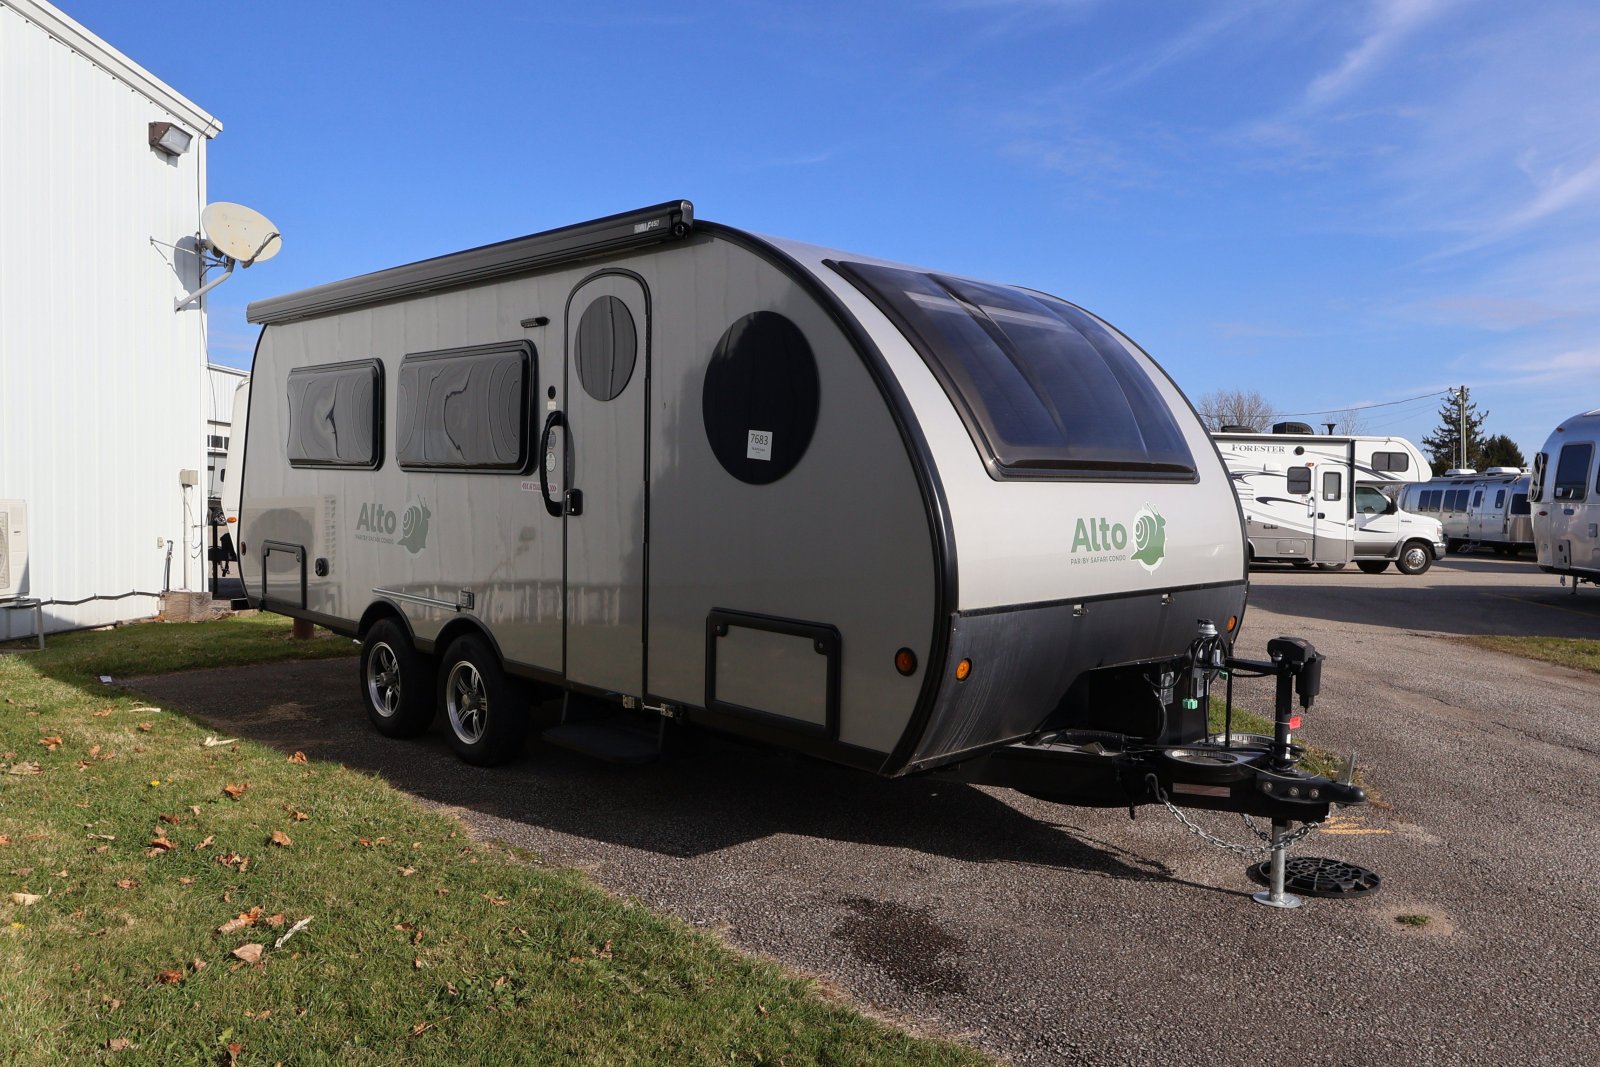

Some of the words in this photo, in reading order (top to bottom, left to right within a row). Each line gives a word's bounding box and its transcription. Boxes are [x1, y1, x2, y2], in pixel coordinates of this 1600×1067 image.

[751, 434, 768, 446] 7683
[356, 502, 397, 535] Alto
[1071, 517, 1128, 553] Alto
[1090, 555, 1108, 564] SAFARI
[1109, 554, 1127, 562] CONDO
